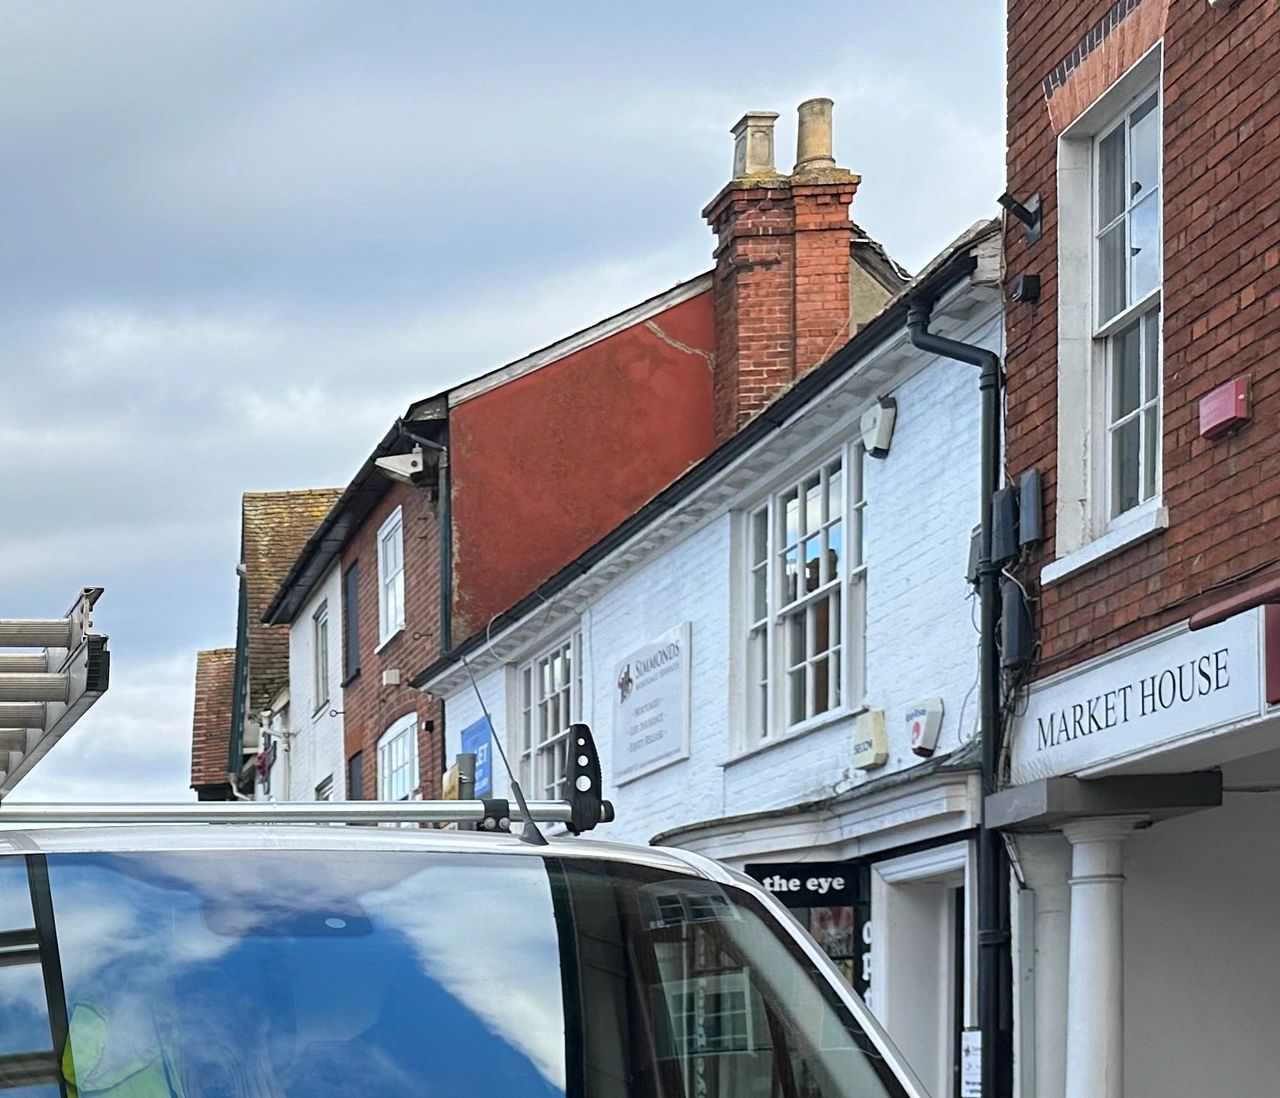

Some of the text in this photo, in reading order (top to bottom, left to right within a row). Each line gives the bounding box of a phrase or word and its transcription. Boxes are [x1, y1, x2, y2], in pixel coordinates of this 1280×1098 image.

[1036, 648, 1231, 751] MARKET HOUSE
[762, 875, 845, 894] the eye
